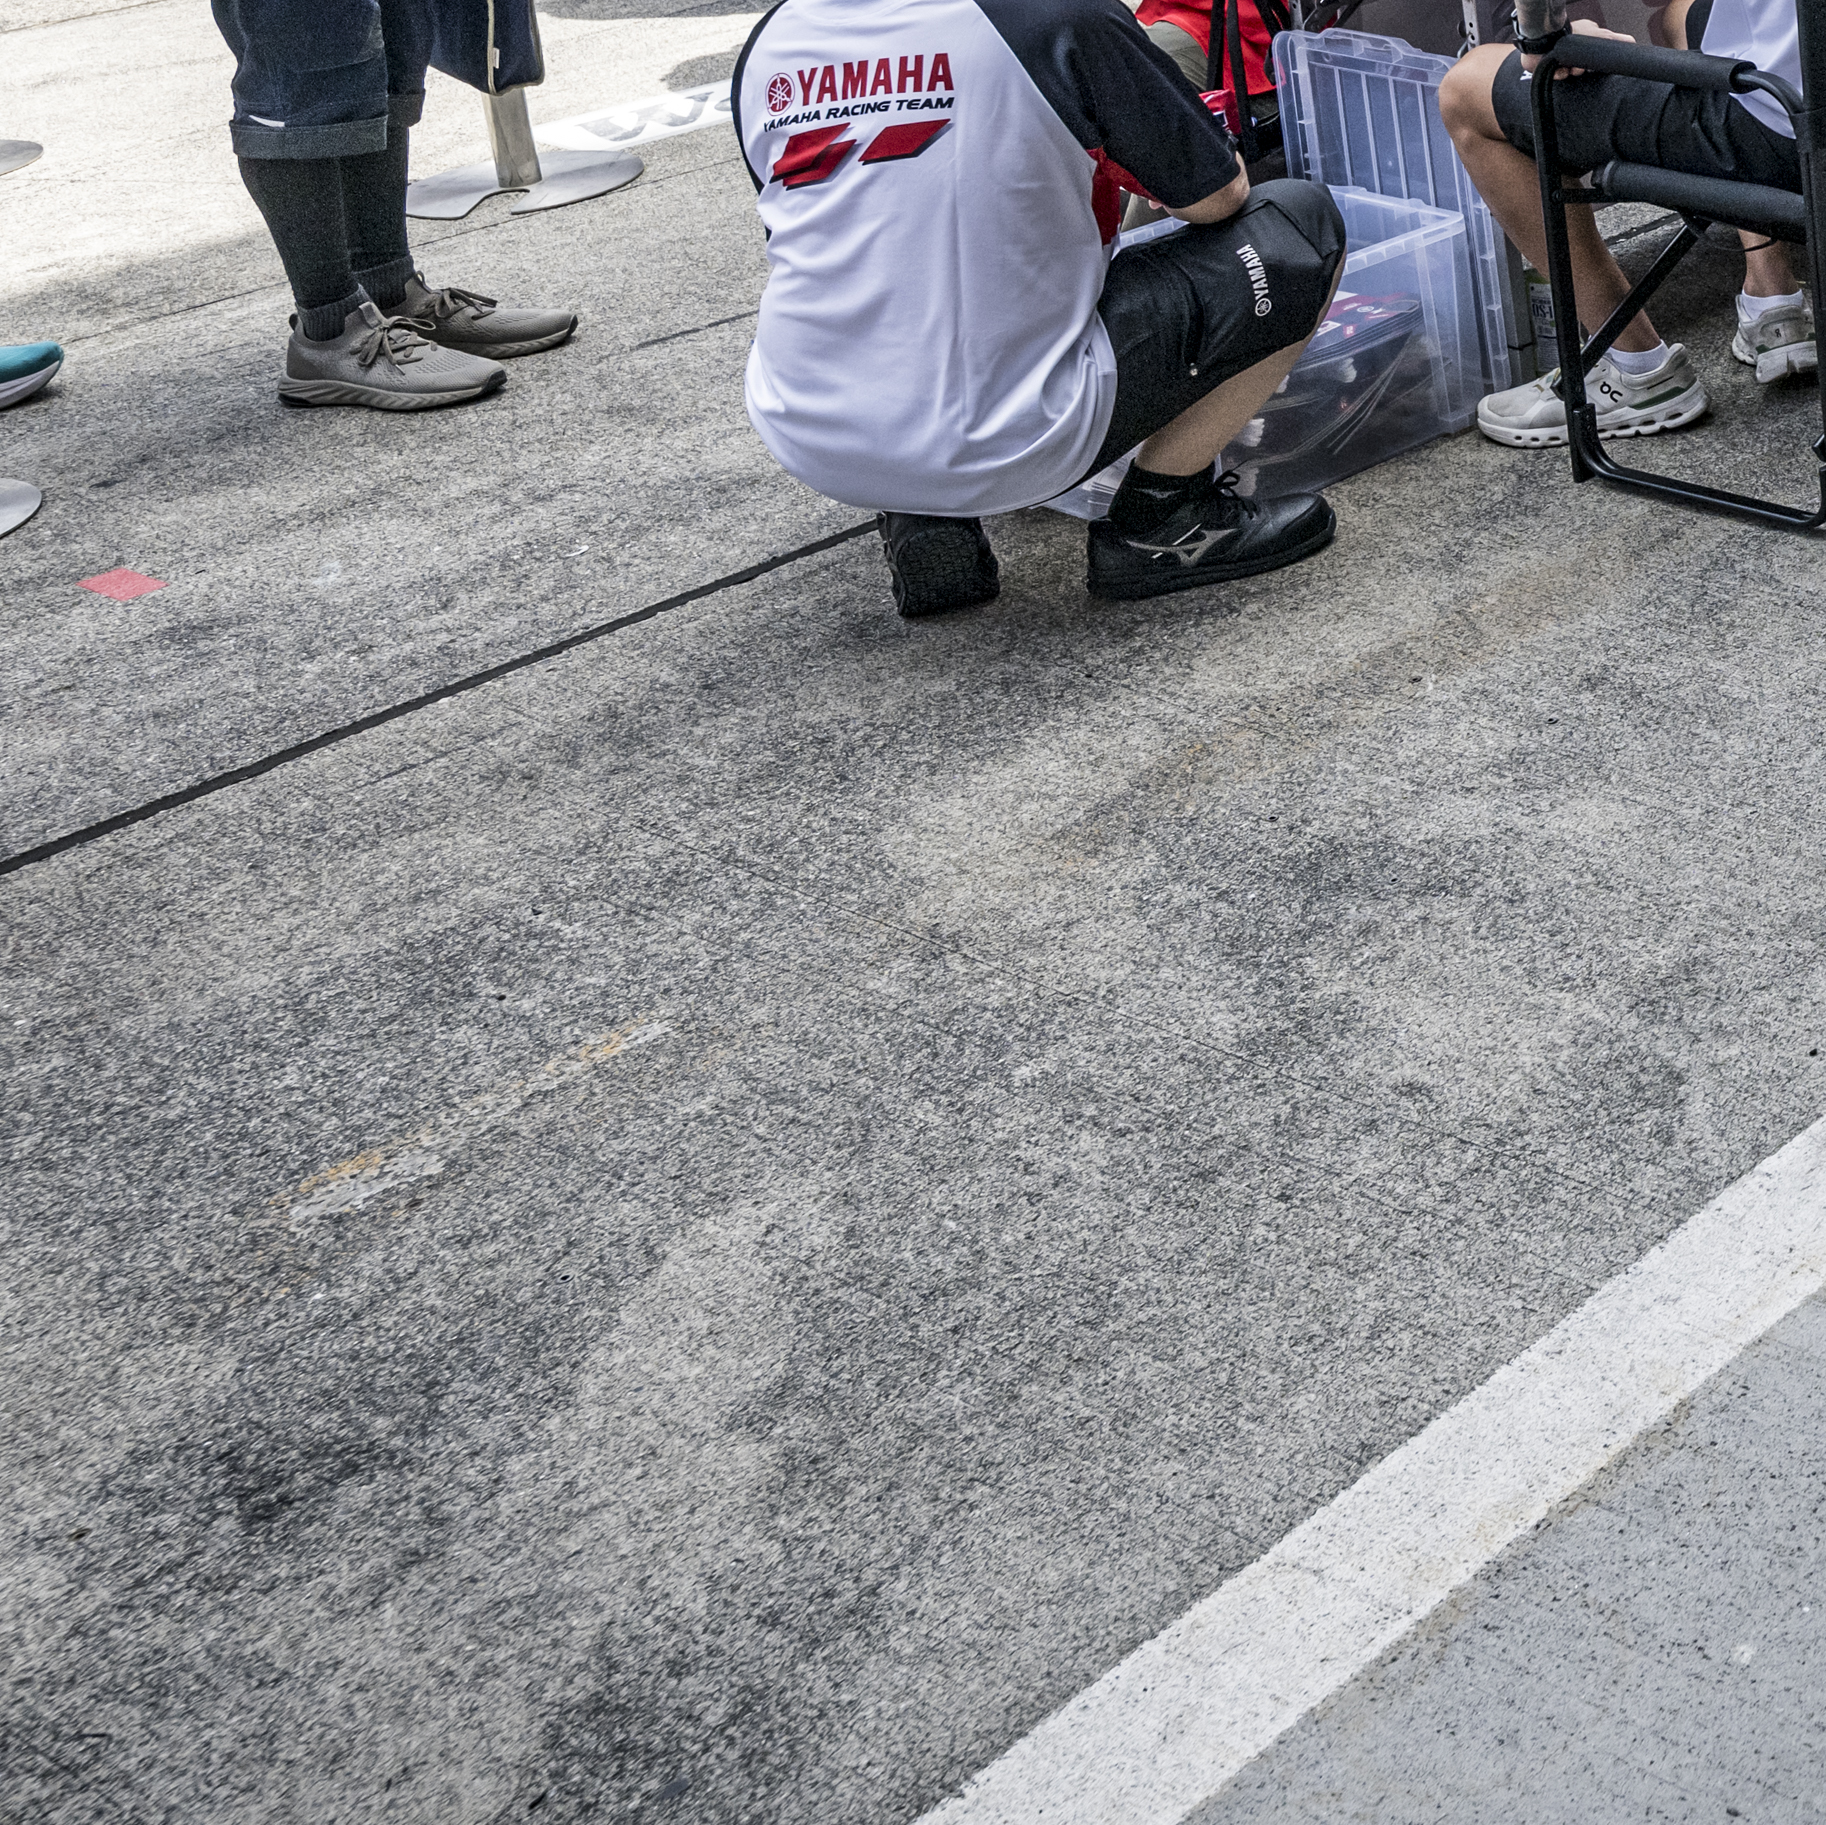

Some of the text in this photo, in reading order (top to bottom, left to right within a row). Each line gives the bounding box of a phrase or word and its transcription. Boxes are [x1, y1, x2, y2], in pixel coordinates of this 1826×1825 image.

[798, 52, 955, 106] YAMAHA
[763, 97, 955, 132] YAMAHA RACING TEAM
[1236, 243, 1269, 301] YAMAHA
